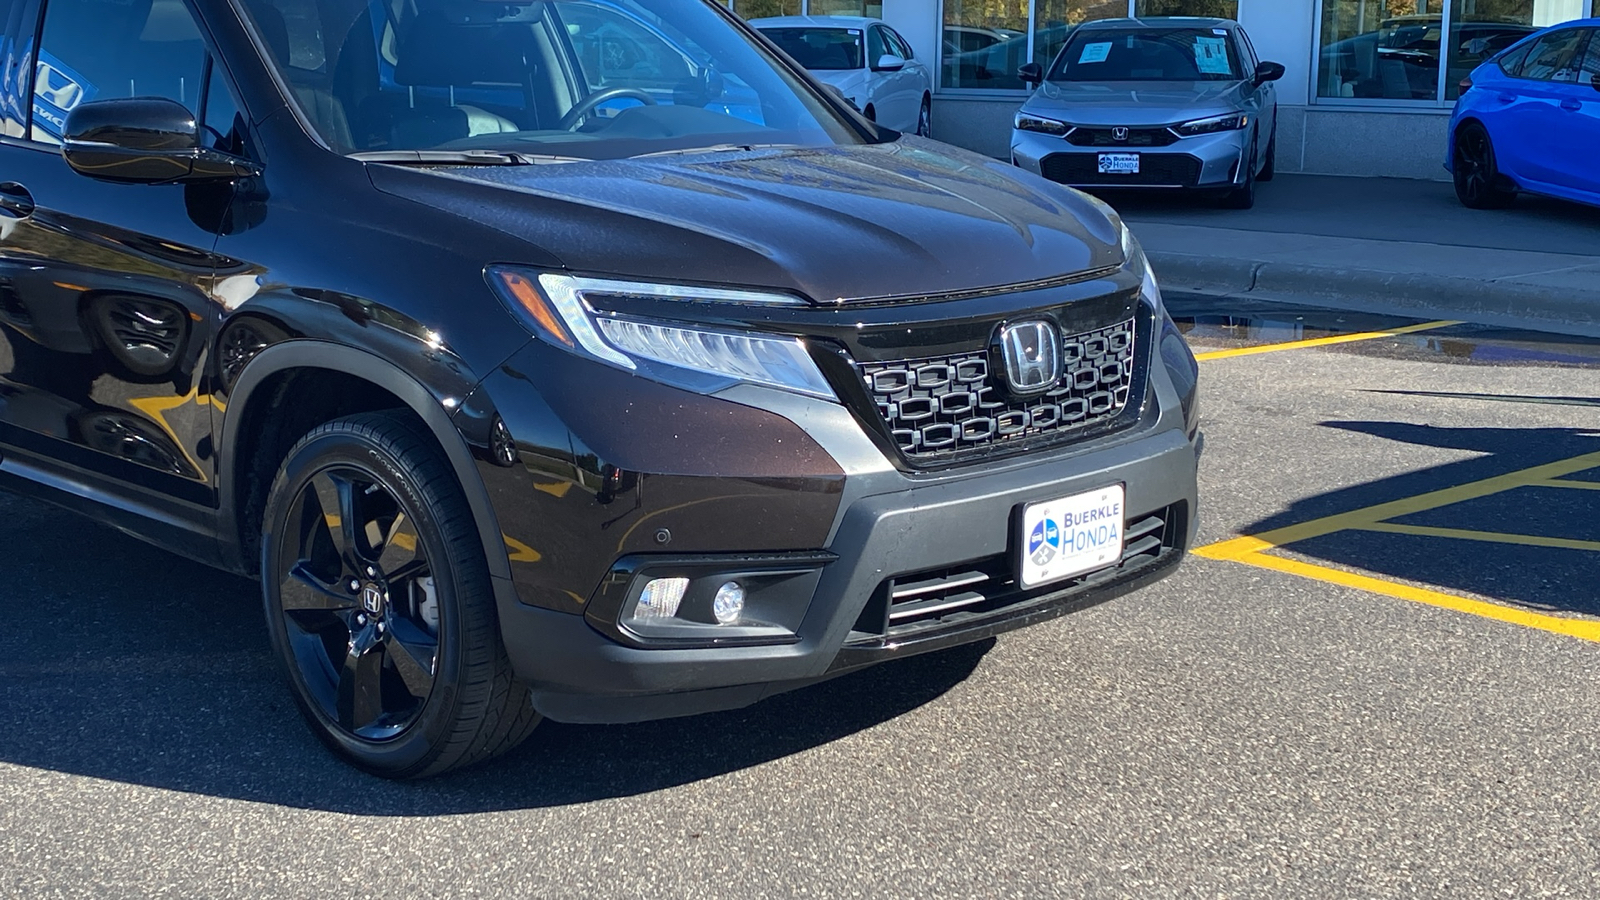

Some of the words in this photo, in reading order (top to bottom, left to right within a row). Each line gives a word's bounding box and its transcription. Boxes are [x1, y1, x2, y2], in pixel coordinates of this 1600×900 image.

[1113, 161, 1138, 169] HONDA
[1064, 503, 1119, 528] BUERKLE
[1062, 523, 1117, 555] HONDA
